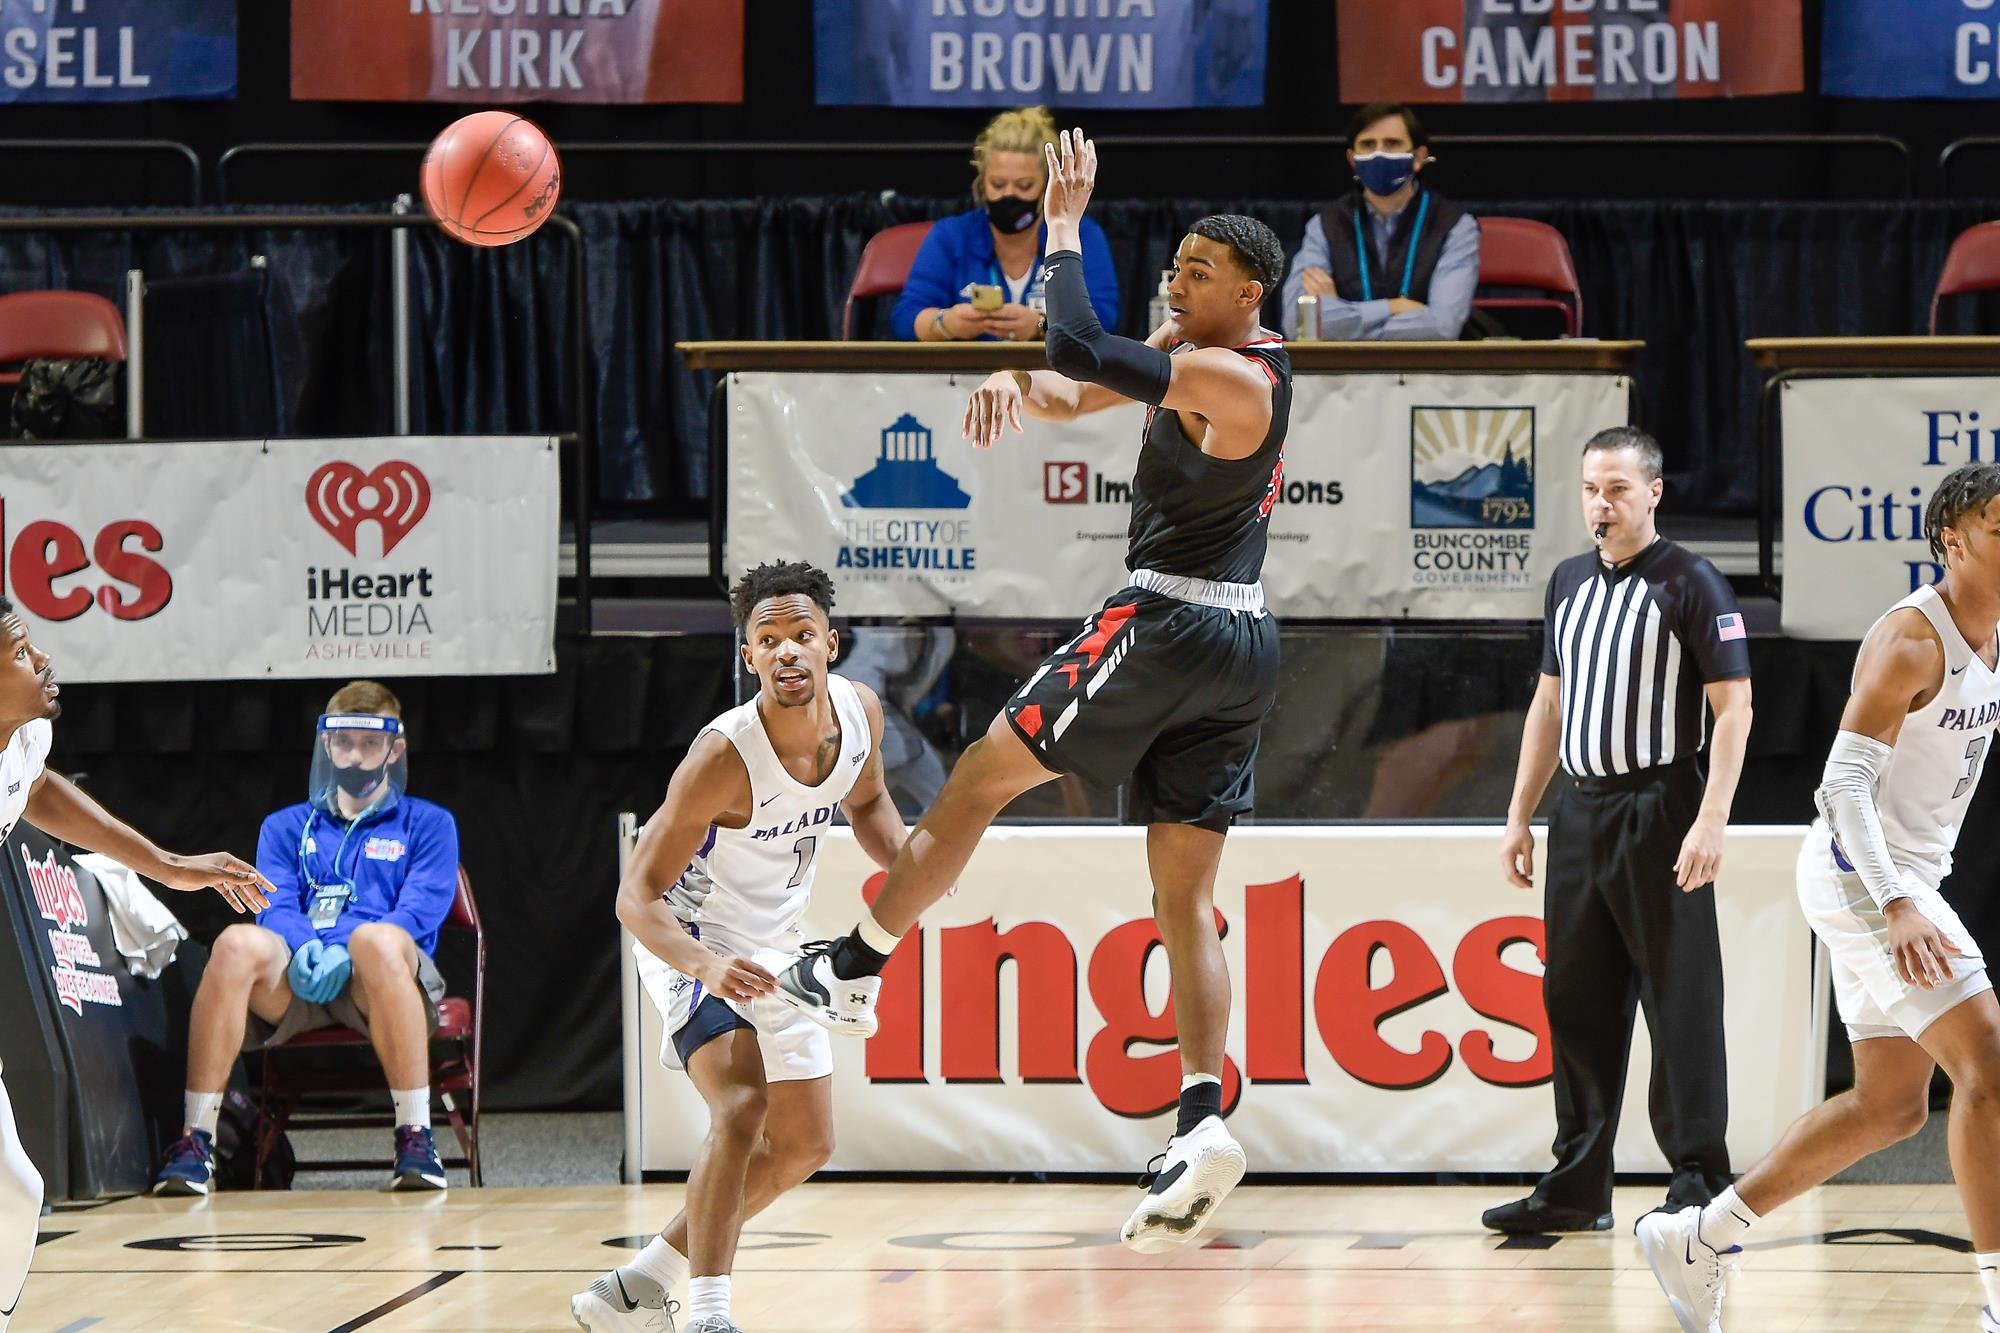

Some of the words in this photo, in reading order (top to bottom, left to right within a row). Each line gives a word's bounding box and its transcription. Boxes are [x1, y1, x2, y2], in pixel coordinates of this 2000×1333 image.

[4, 26, 151, 89] SELL
[447, 29, 586, 89] KIRK
[929, 31, 1154, 93] BROWN
[1420, 21, 1721, 89] CAMERON
[1955, 21, 2000, 86] C
[1482, 501, 1531, 524] 1792
[1803, 484, 1932, 543] Citi
[0, 494, 173, 622] es
[836, 545, 977, 570] ASHEVILLE
[1413, 533, 1531, 550] BUNCOMBE
[1413, 551, 1530, 571] COUNTY
[306, 566, 433, 600] iHeart
[1412, 571, 1532, 584] GOVERNMENT
[307, 602, 433, 637] MEDIA
[305, 642, 433, 660] ASHEVILLE
[1951, 735, 1987, 800] 3
[786, 835, 817, 889] 1
[862, 871, 1554, 1119] ingles
